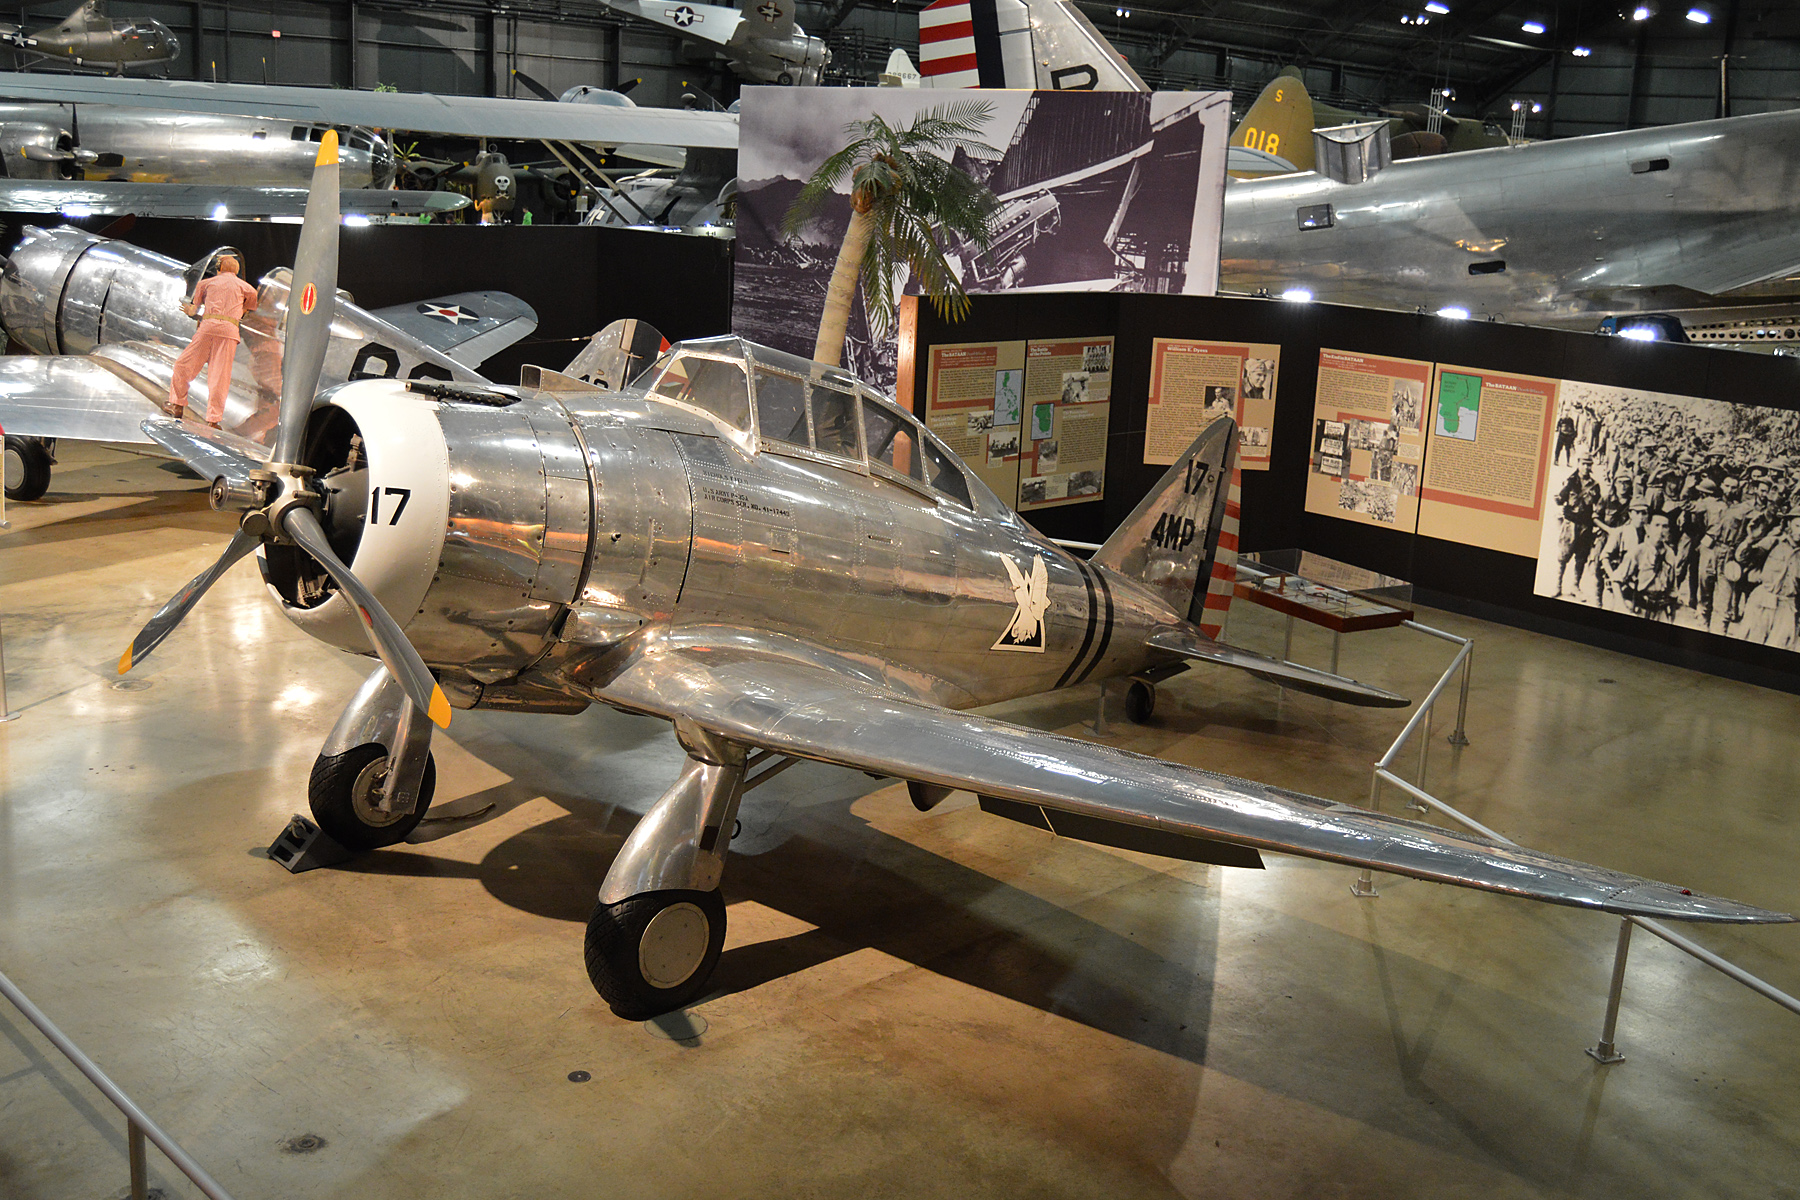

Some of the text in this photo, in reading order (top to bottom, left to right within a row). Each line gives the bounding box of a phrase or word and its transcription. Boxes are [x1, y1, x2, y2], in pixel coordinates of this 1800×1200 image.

[1275, 89, 1283, 102] S
[1244, 127, 1280, 155] 018
[1495, 383, 1517, 391] BATAAN
[1184, 459, 1209, 495] 17
[371, 486, 411, 526] 17
[716, 496, 734, 506] CORPS
[1151, 512, 1196, 552] 4MP
